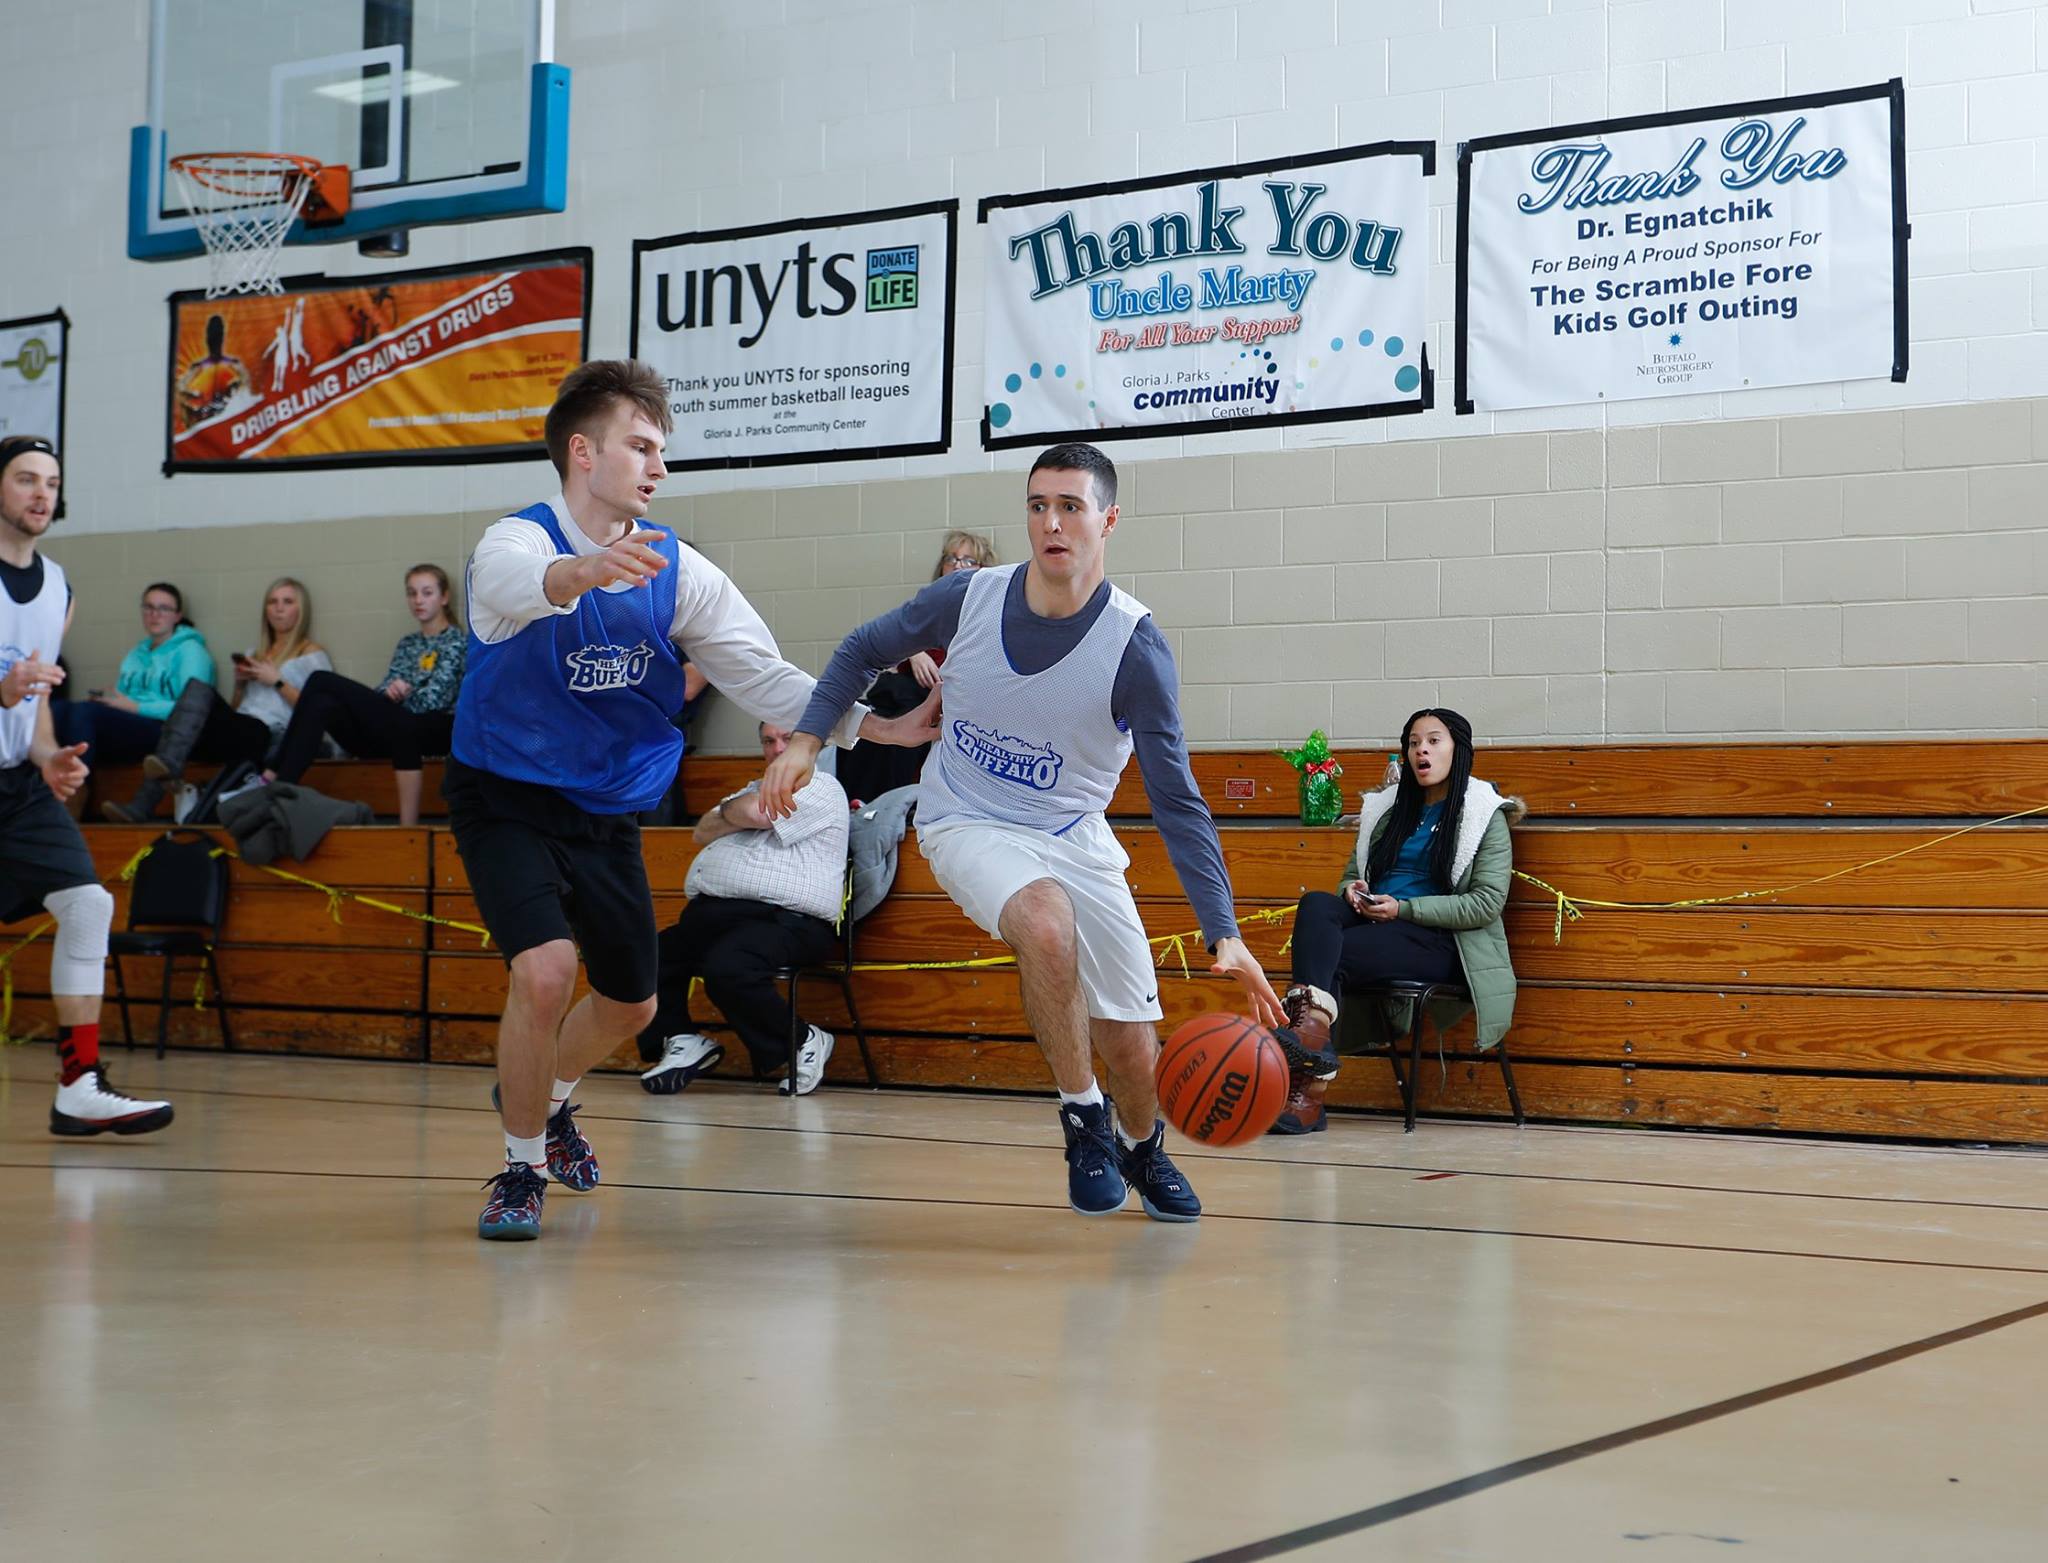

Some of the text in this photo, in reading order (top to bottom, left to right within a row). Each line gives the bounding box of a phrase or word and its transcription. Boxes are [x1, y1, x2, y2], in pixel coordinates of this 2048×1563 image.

[1517, 117, 1847, 215] Thank You
[1577, 198, 1774, 241] Dr. Egnatchik
[1009, 180, 1402, 301] Thank You
[1531, 230, 1823, 275] For Being A Proud Sponsor For
[871, 251, 915, 268] DONATE
[657, 241, 857, 348] unyts
[871, 279, 913, 305] LIFE
[1088, 266, 1315, 320] Uncle Marty
[1530, 263, 1813, 308] The Scramble Fore
[1553, 295, 1798, 336] Kids Golf Outing
[1096, 313, 1302, 352] For All Your Support
[231, 283, 515, 445] DRIBBLING AGAINST DRUGS
[1636, 361, 1714, 376] NEUROSURGERY
[1653, 352, 1697, 364] BUFFALO
[667, 360, 910, 392] Thank you UNYTS for sponsoring
[1122, 369, 1211, 388] Gloria J. Parks
[1657, 373, 1693, 384] GROUP
[670, 384, 910, 414] outh summer basketball leagues
[1133, 376, 1280, 410] community
[773, 410, 797, 419] at the
[1211, 405, 1256, 418] Center
[704, 428, 732, 439] Gloria
[746, 426, 772, 436] Parks
[775, 421, 830, 434] Community
[833, 419, 866, 430] Center
[978, 738, 1034, 764] HEALTHY
[1195, 1071, 1250, 1141] Wilson
